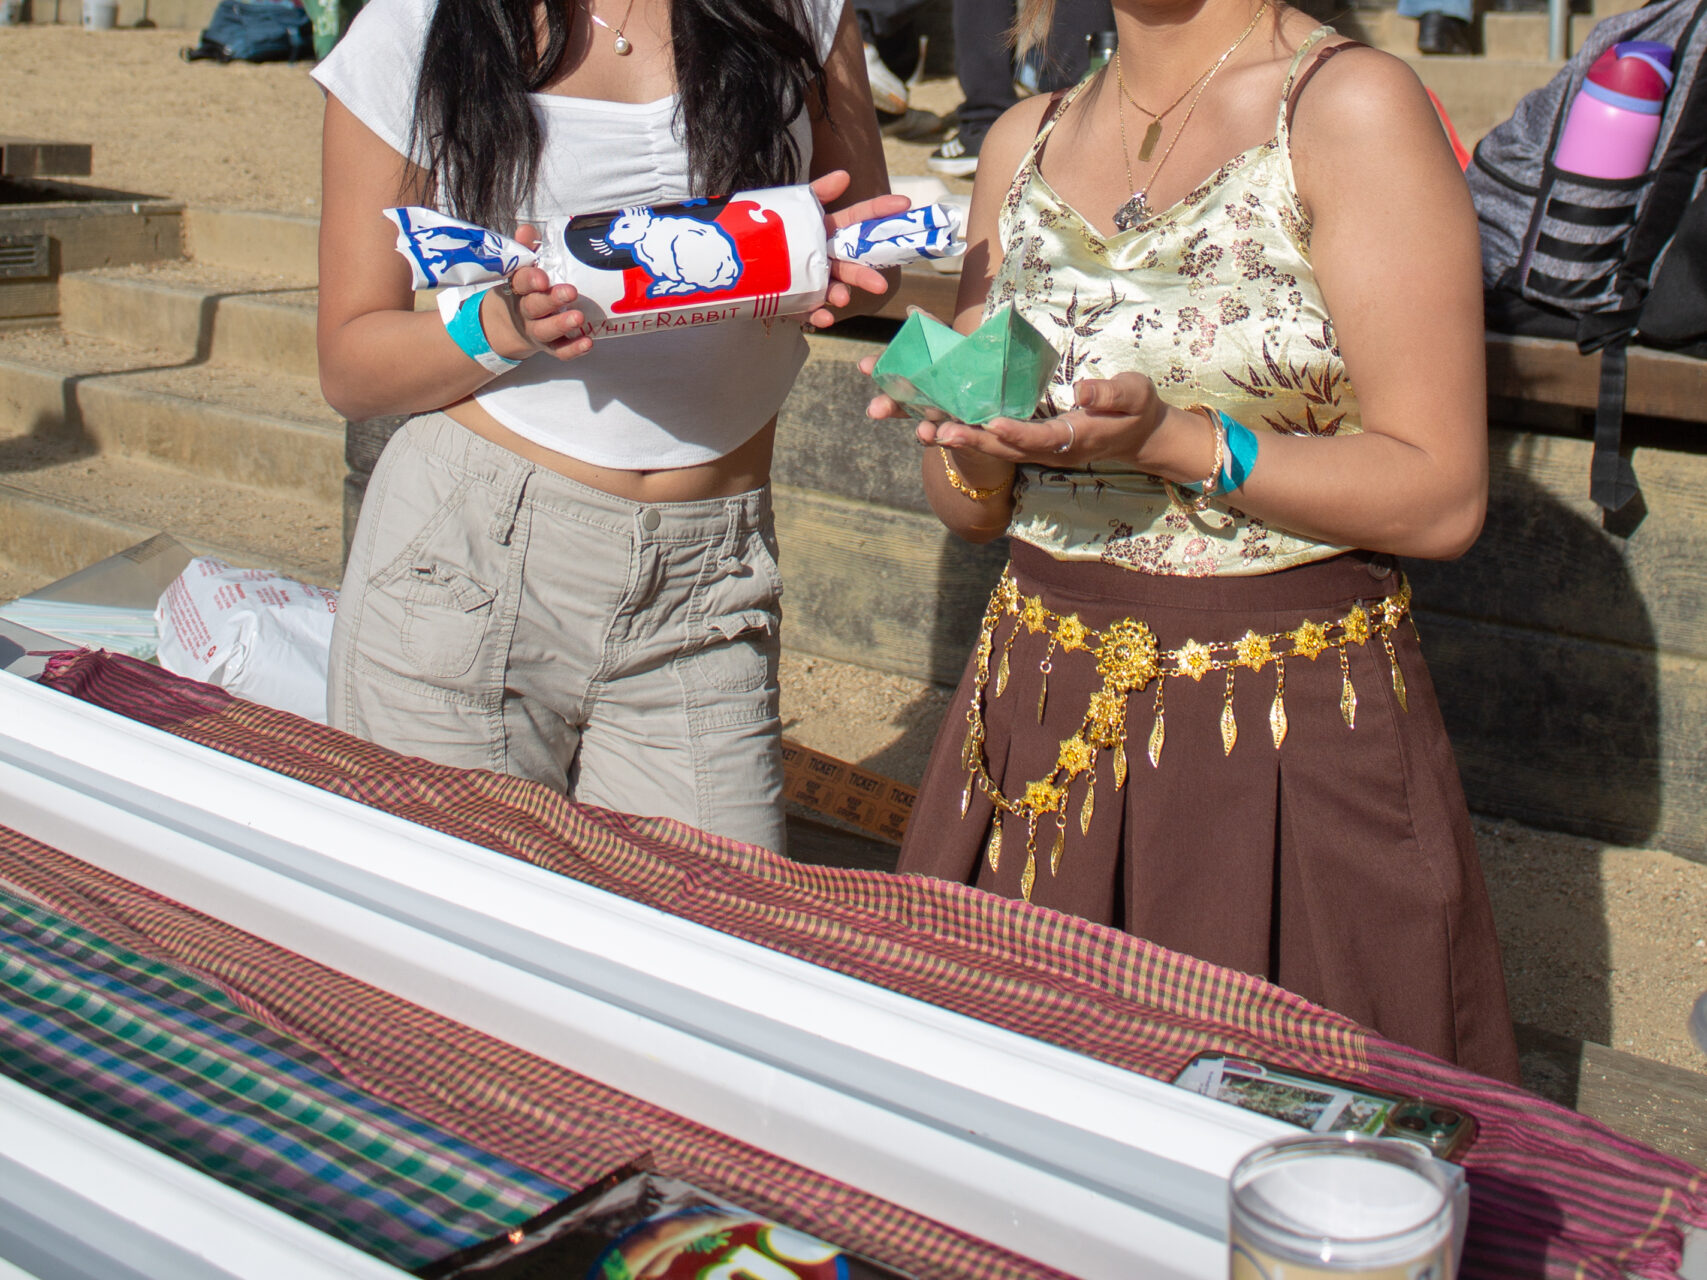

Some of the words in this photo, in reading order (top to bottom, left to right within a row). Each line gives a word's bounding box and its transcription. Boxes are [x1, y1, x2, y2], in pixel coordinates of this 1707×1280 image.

[809, 758, 837, 776] TICKET
[850, 774, 878, 793] TICKET
[891, 788, 916, 807] TICKE
